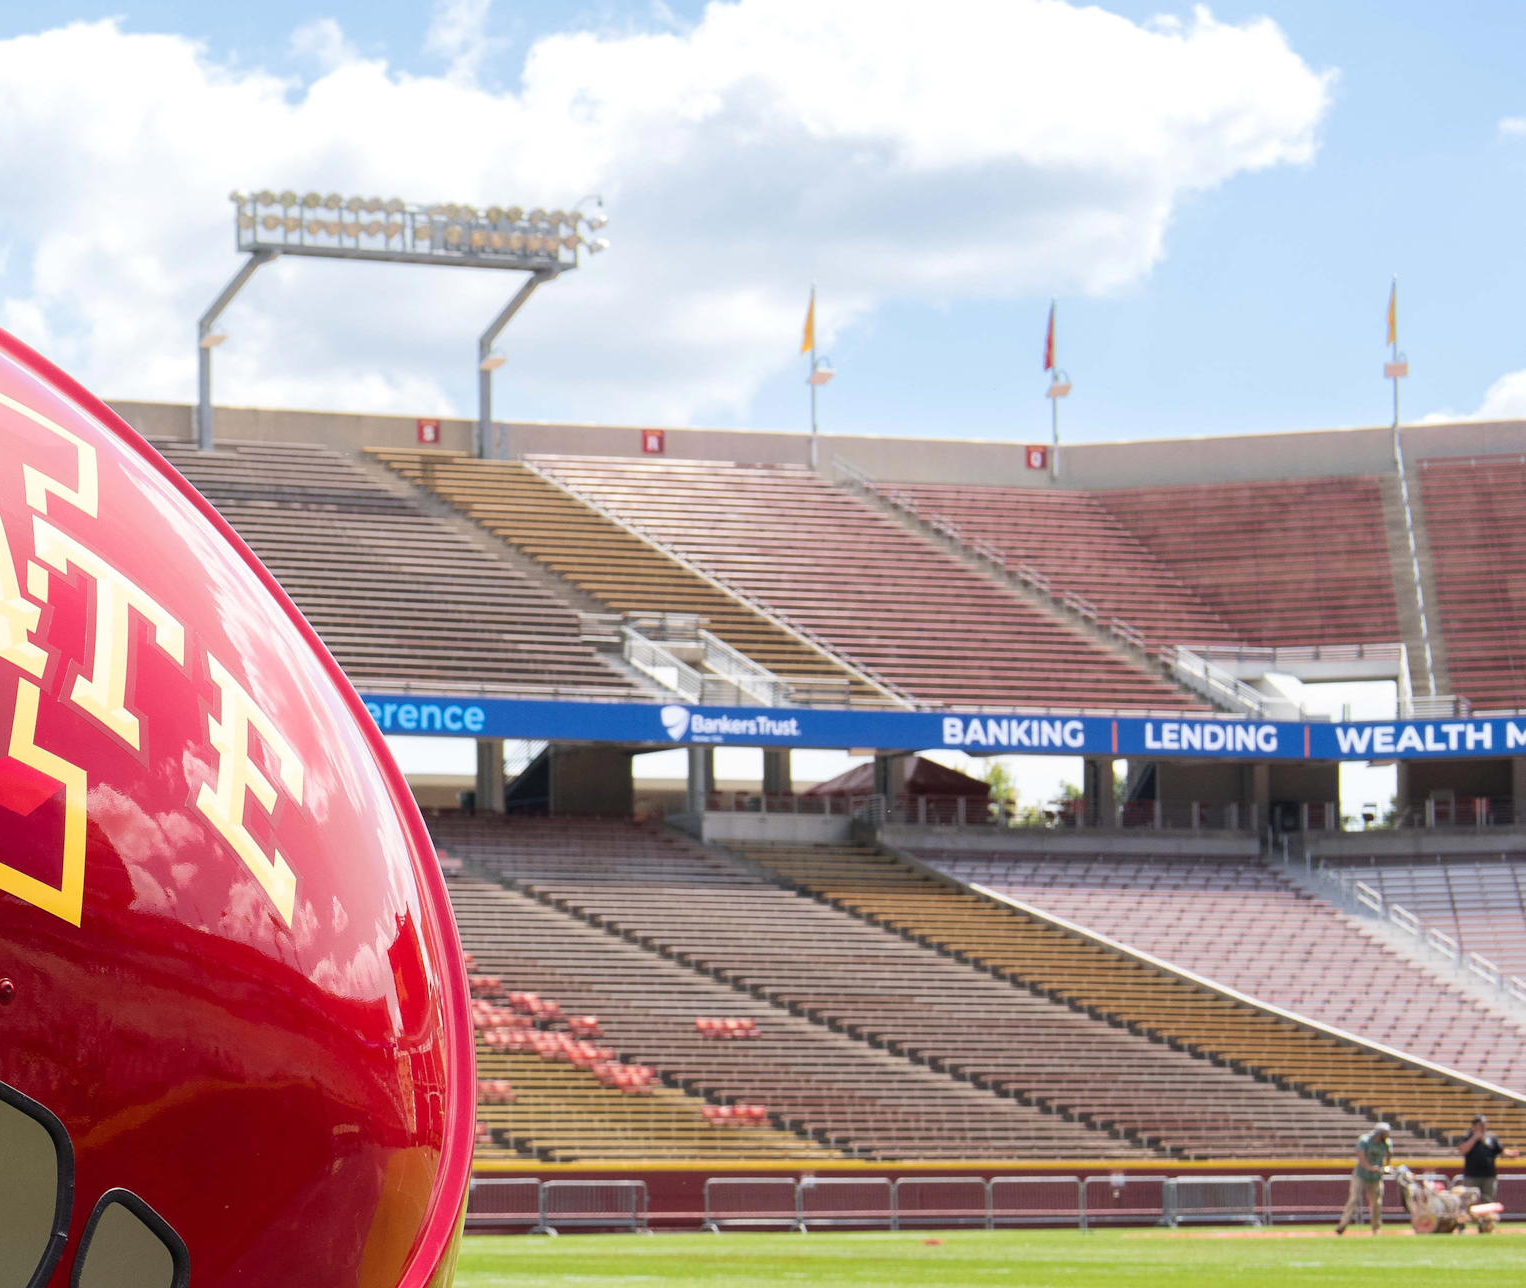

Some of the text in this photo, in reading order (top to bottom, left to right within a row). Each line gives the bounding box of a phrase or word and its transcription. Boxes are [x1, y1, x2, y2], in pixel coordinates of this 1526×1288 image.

[942, 717, 1085, 747] BANKING
[1144, 721, 1278, 752] LENDING
[1335, 722, 1492, 754] WEALTH
